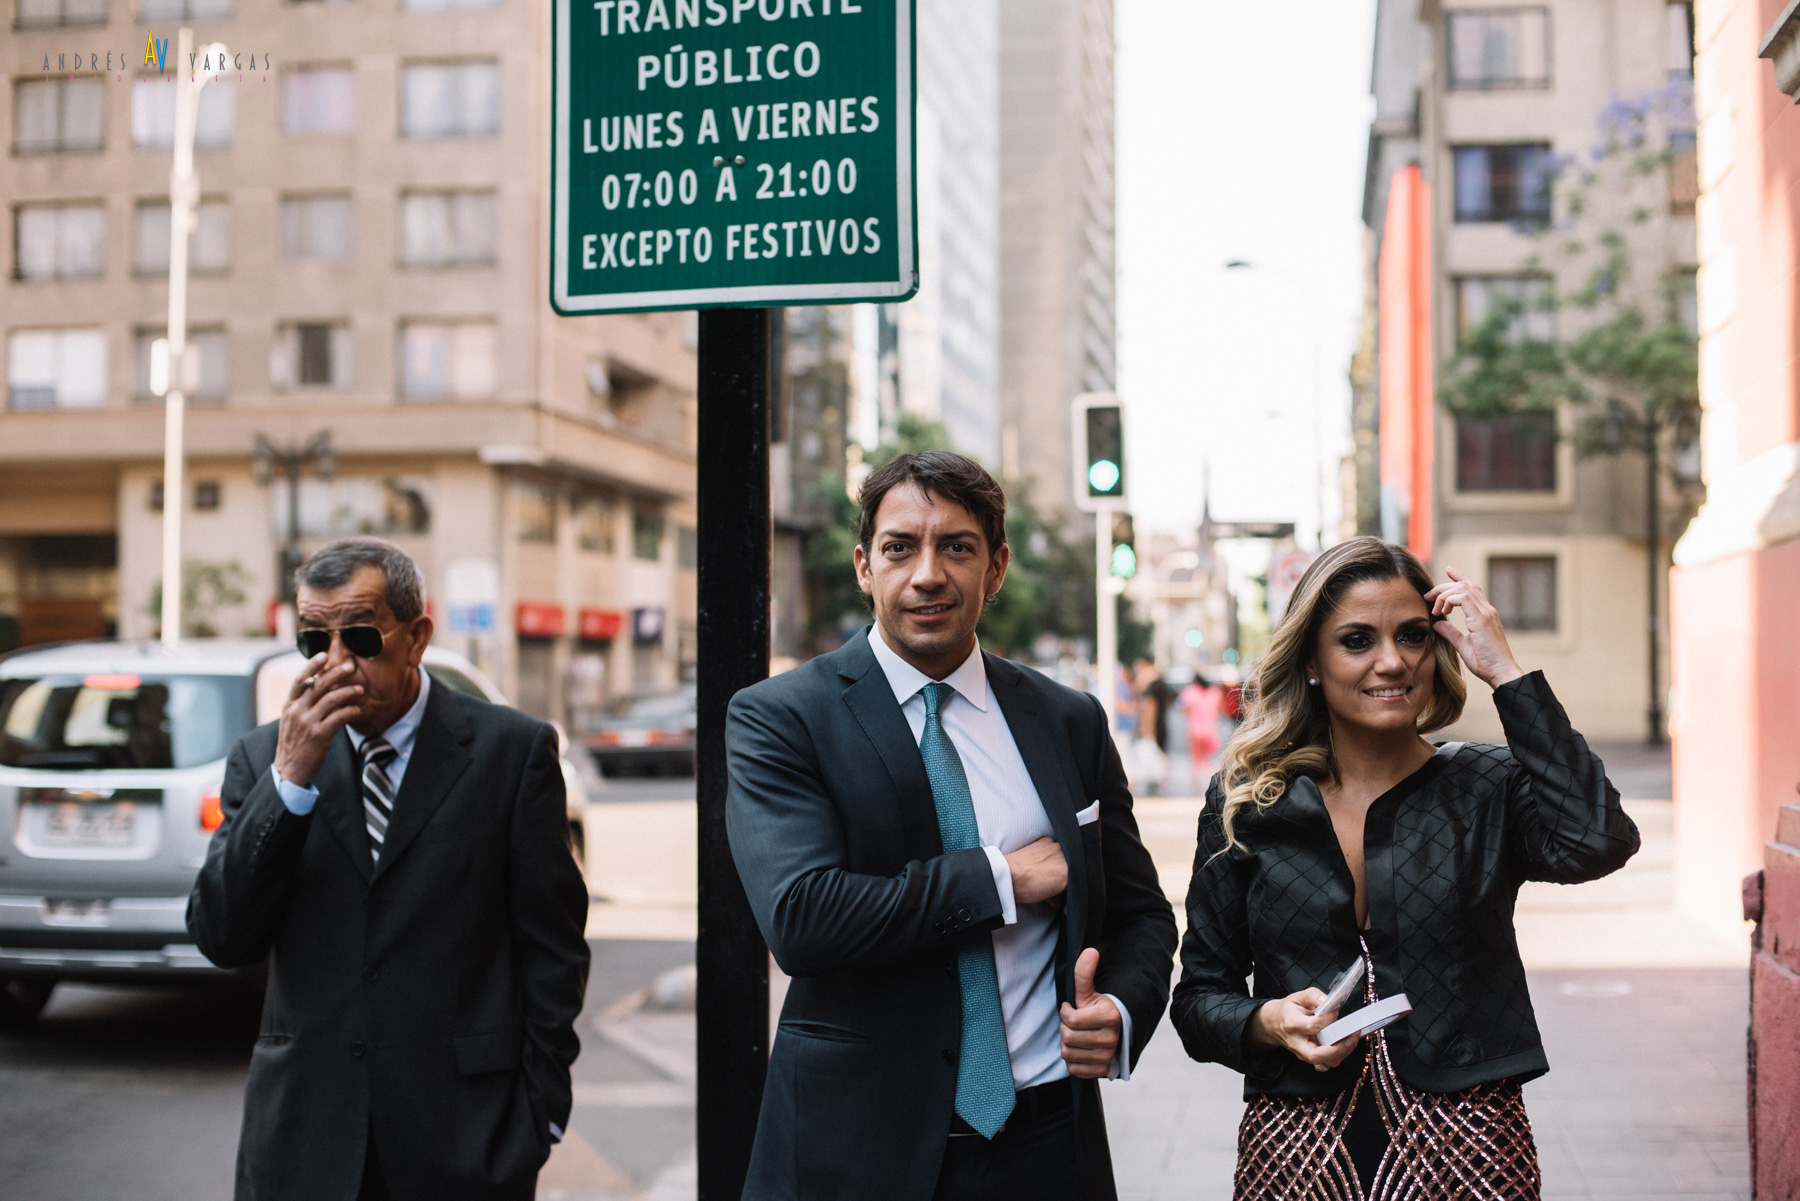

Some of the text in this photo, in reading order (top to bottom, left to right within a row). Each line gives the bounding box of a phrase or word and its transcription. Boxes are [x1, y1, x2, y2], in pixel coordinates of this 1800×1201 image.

[638, 41, 820, 91] PÚBLICO
[583, 96, 880, 154] LUNES A VIERNES
[602, 157, 857, 211] 07:00 A 21:00
[582, 217, 881, 270] EXCEPTO FESTIVOS
